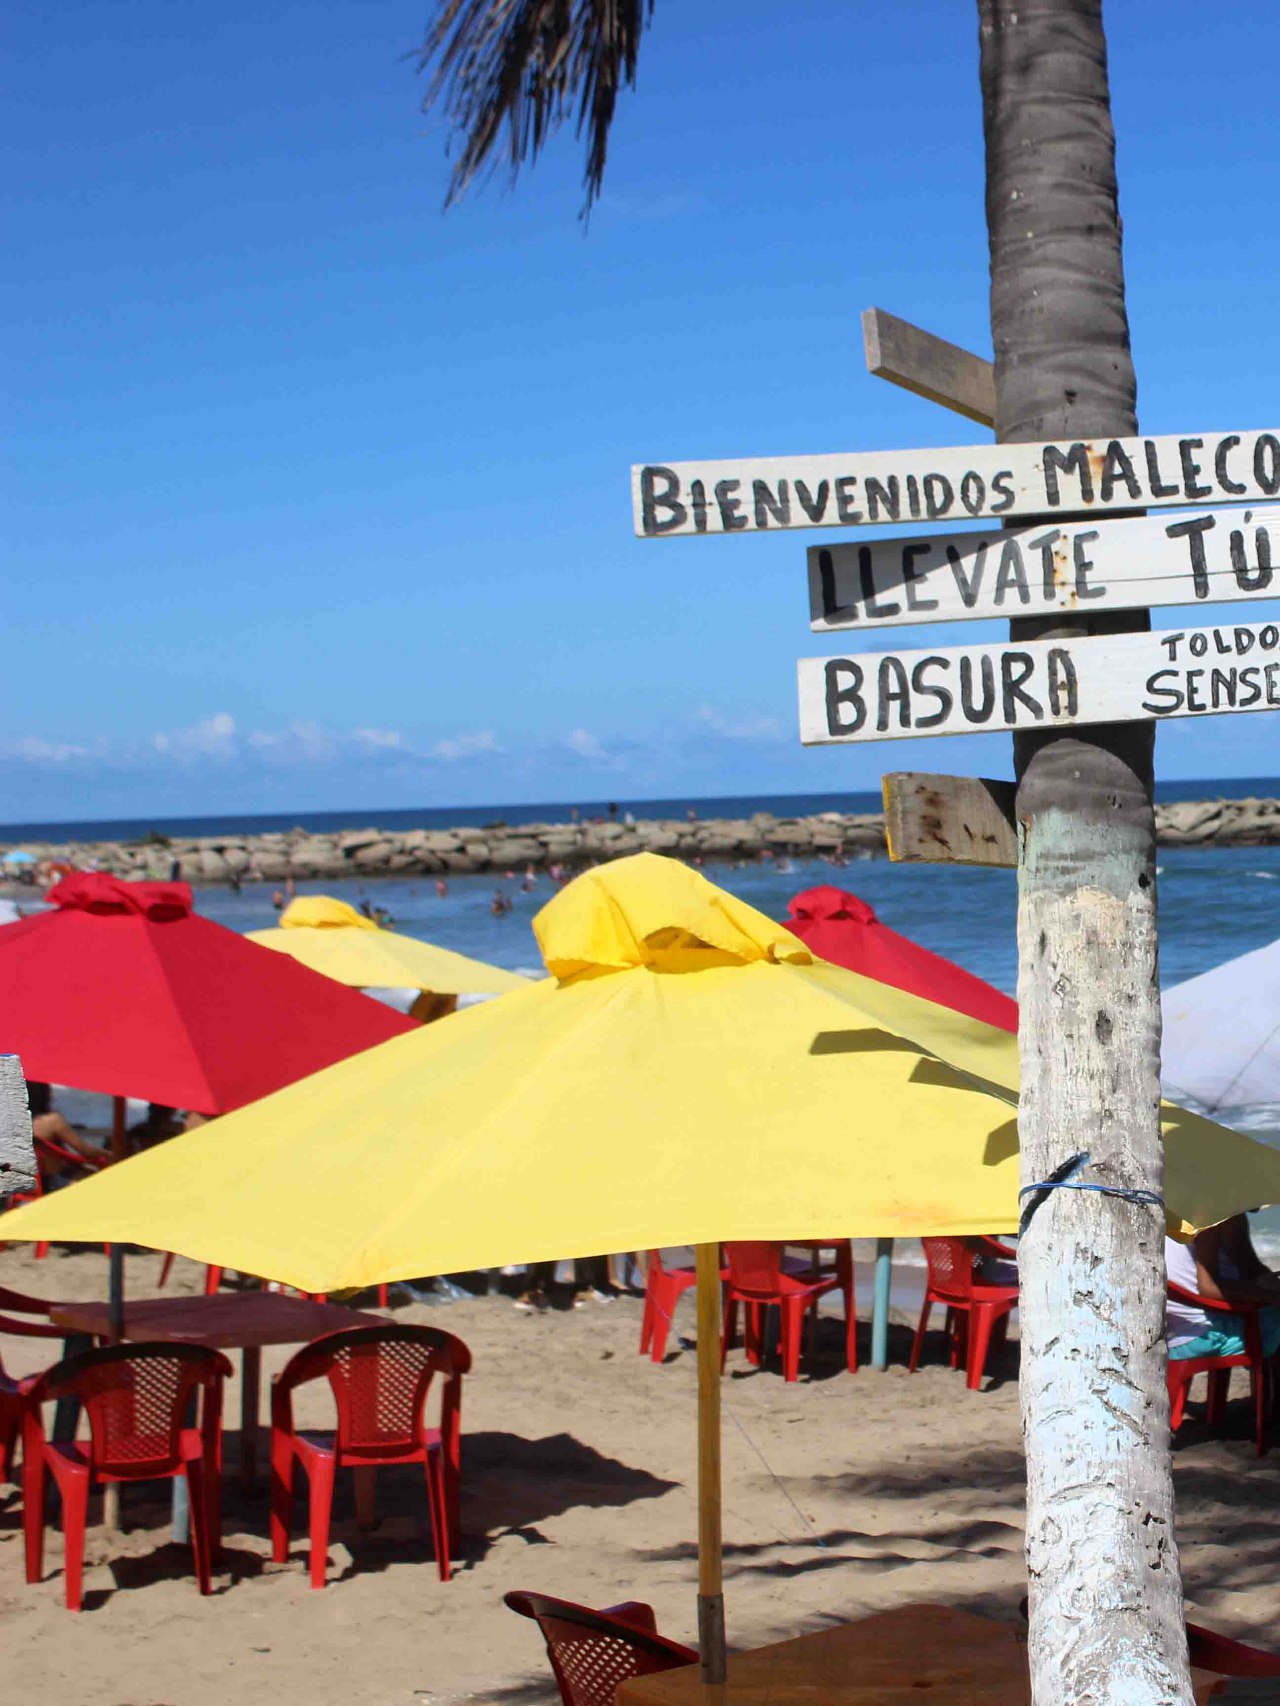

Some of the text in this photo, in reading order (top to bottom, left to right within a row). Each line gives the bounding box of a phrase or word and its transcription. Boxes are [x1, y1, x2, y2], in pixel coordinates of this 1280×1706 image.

[640, 466, 1016, 534] BIENVENIDOS
[818, 510, 1273, 624] LLEVATE TÚ
[824, 648, 1079, 737] BASURA
